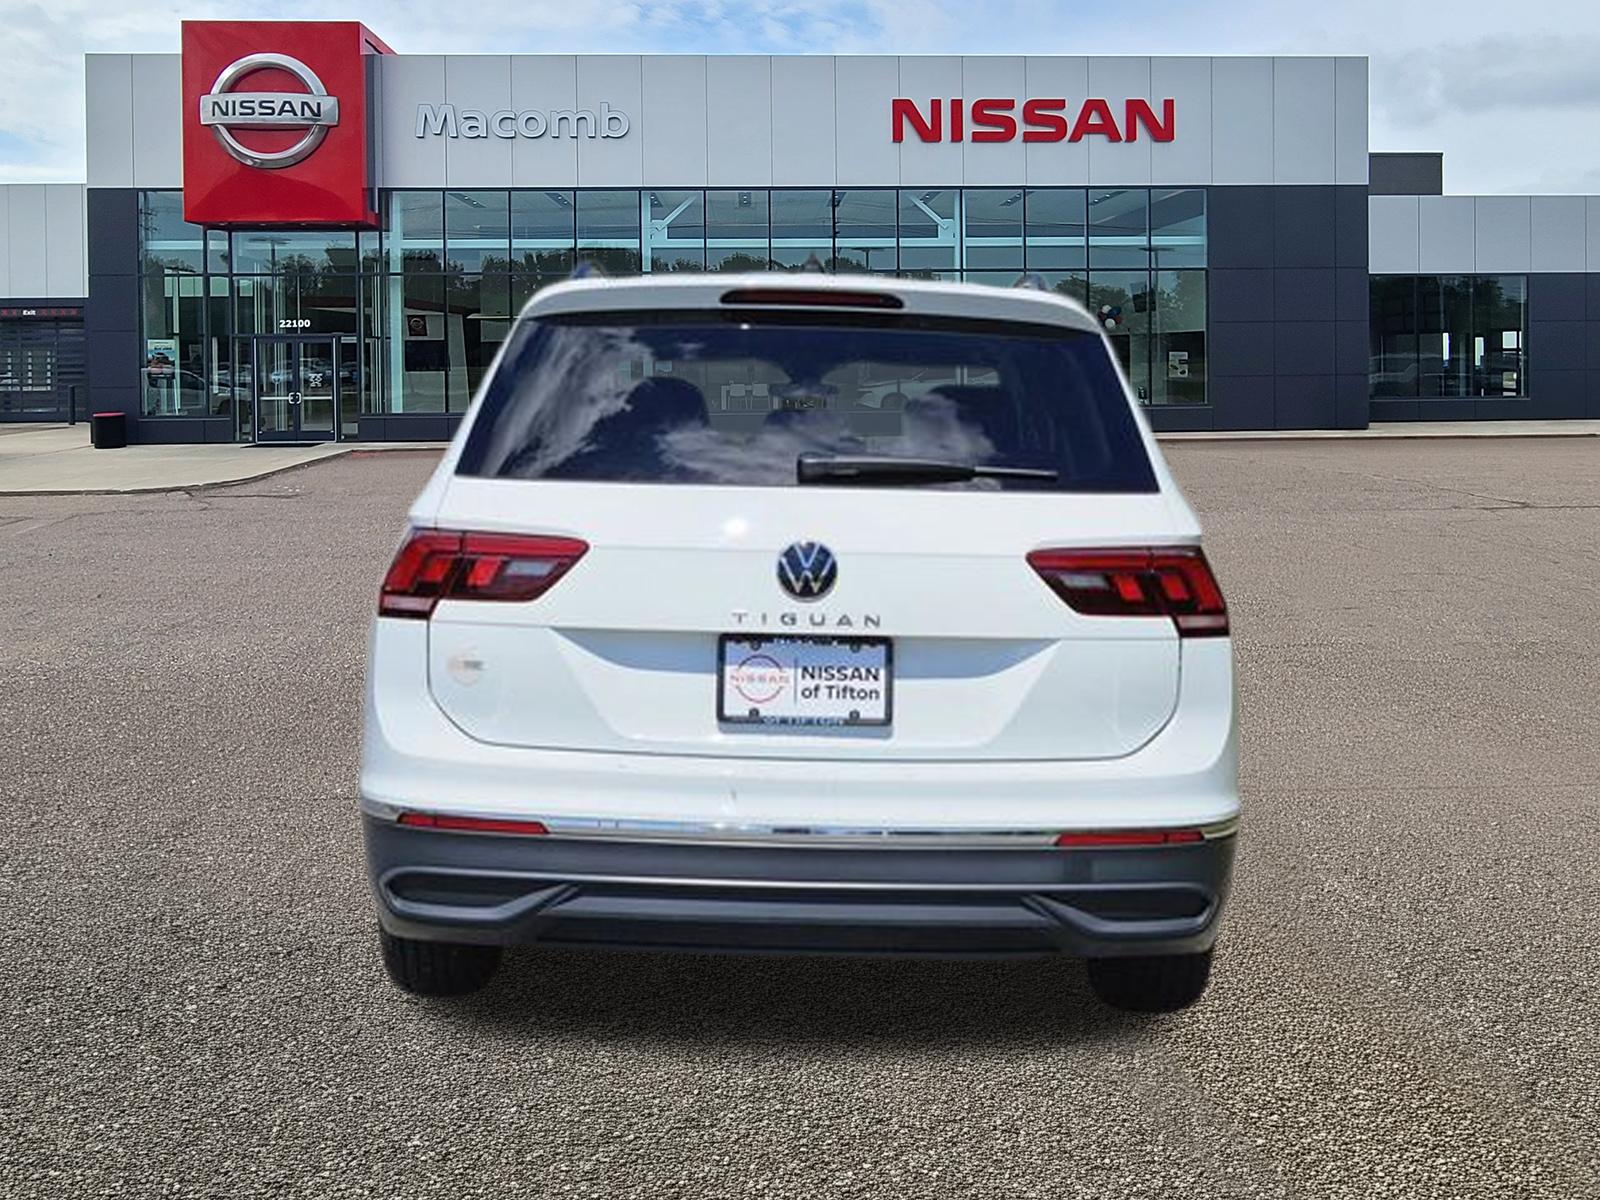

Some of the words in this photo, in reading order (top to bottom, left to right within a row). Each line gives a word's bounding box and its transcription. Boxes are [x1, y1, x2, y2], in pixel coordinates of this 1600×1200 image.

[212, 100, 322, 117] NISSAN
[415, 102, 630, 138] Macomb
[892, 98, 1175, 142] NISSAN
[279, 319, 311, 328] 22100
[732, 613, 880, 628] TIGUAN
[730, 674, 790, 684] NISSAN
[801, 665, 880, 682] NISSAN
[801, 684, 820, 698] of
[825, 684, 880, 700] Tifton
